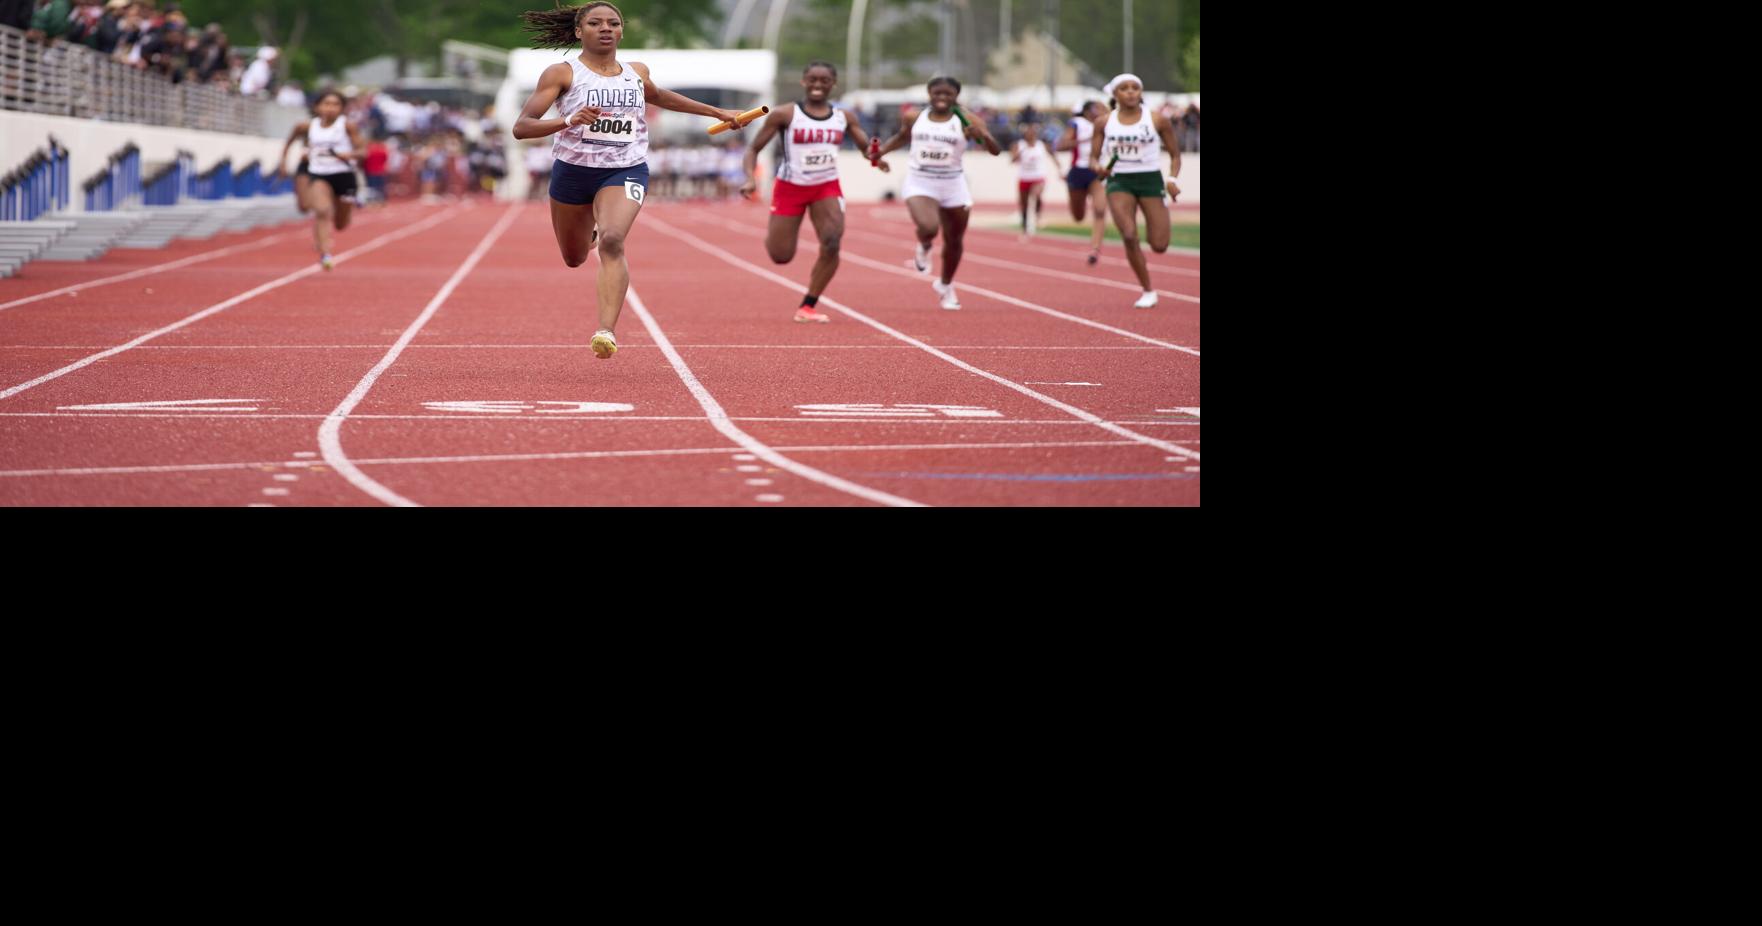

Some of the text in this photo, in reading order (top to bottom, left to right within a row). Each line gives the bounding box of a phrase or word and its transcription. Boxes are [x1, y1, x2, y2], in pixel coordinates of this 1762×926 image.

[586, 88, 644, 109] ALLEN
[590, 119, 633, 135] 8004
[630, 184, 642, 200] 6
